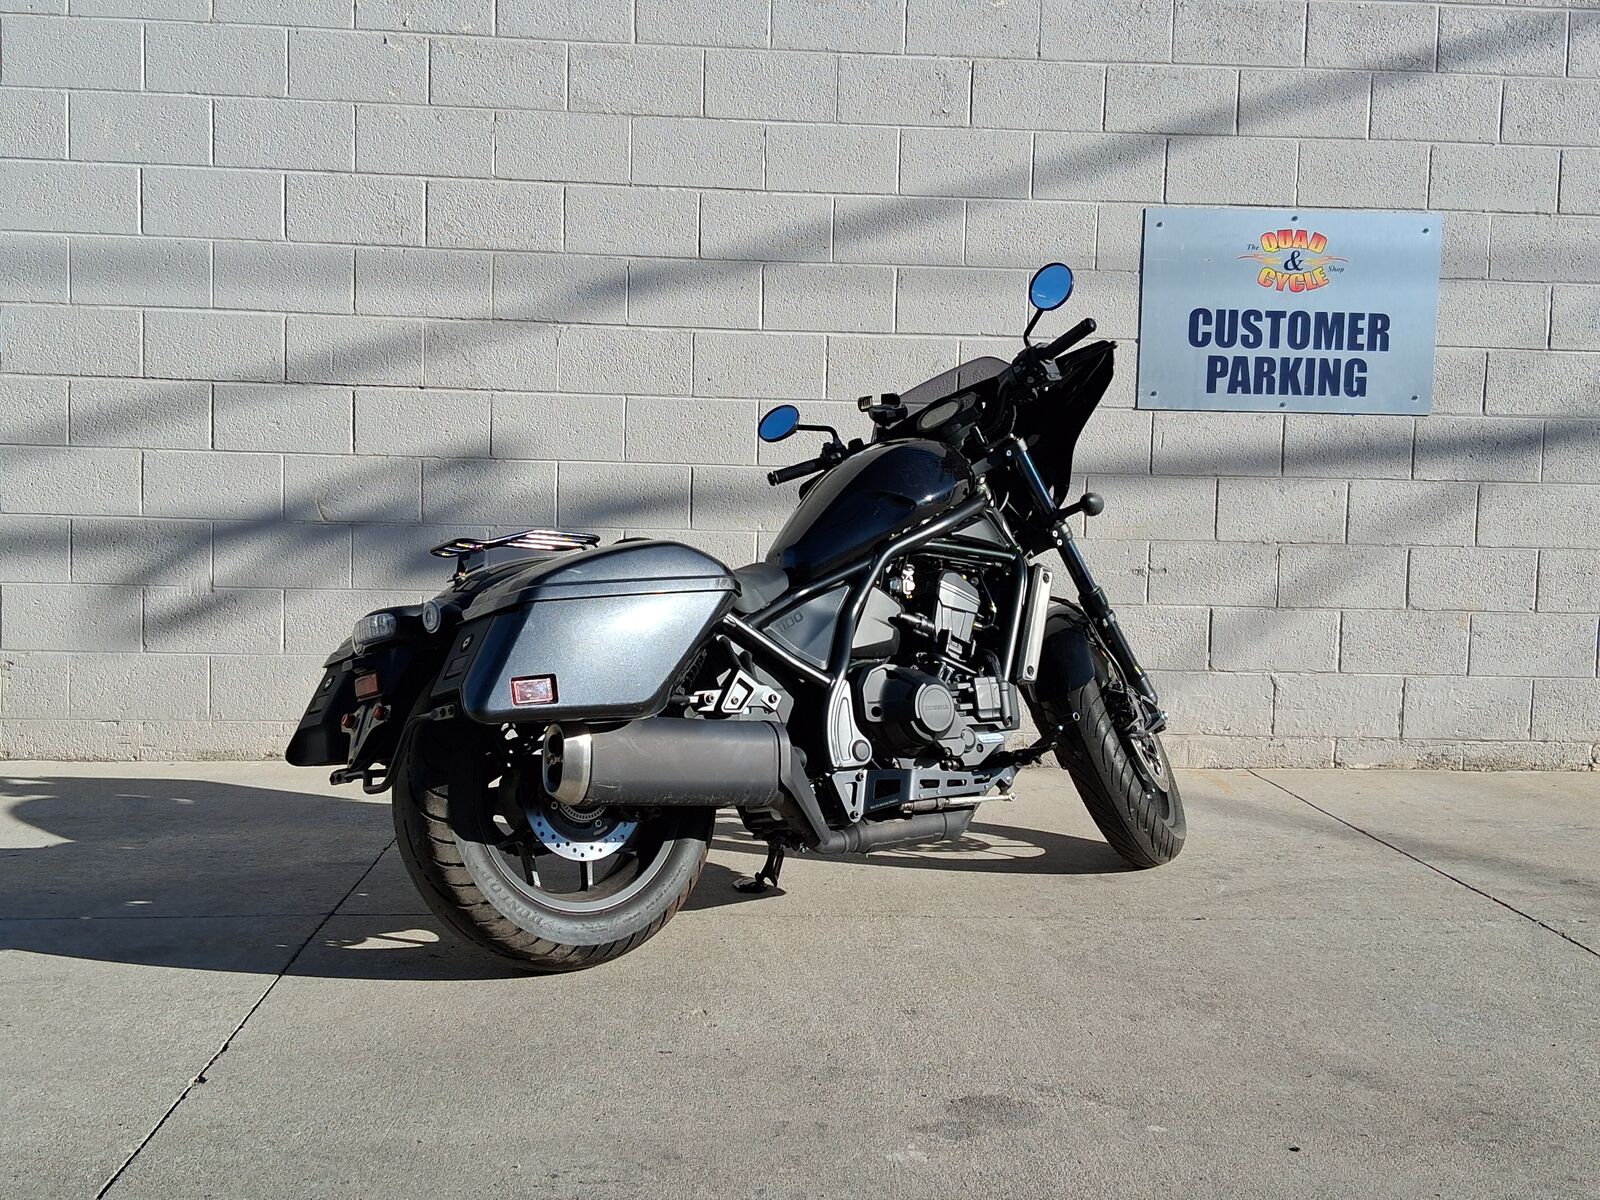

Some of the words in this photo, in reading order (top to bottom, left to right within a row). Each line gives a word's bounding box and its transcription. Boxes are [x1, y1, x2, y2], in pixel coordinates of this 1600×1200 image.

[1247, 243, 1260, 251] The
[1260, 229, 1328, 254] QUAD
[1283, 250, 1304, 271] &
[1257, 266, 1329, 293] CYCLE
[1328, 265, 1344, 275] Shop
[1188, 308, 1391, 352] CUSTOMER
[1206, 355, 1367, 398] PARKING
